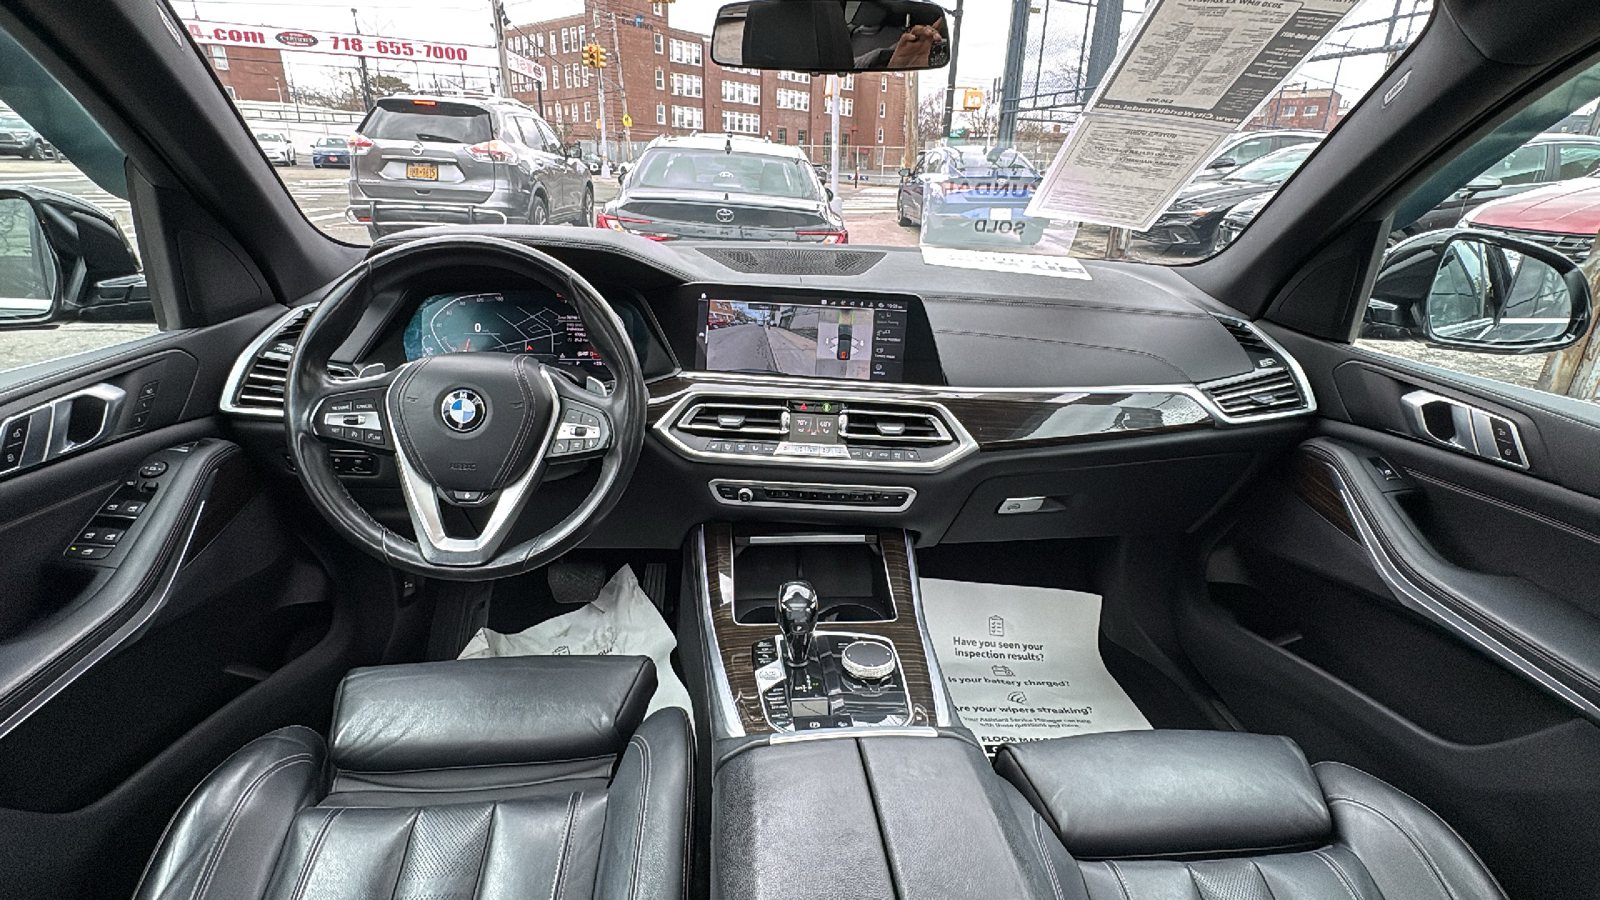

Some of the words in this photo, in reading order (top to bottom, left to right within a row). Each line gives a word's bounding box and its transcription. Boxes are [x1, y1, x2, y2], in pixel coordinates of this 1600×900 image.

[474, 322, 482, 333] 0
[953, 636, 977, 646] Have
[979, 640, 996, 648] you
[998, 641, 1020, 649] seen
[1021, 643, 1044, 651] your
[955, 648, 1005, 659] inspection
[1007, 653, 1044, 661] results?
[983, 676, 1021, 687] battery
[1024, 679, 1070, 687] charged?
[999, 706, 1035, 714] wipers
[1037, 706, 1093, 715] streaking?
